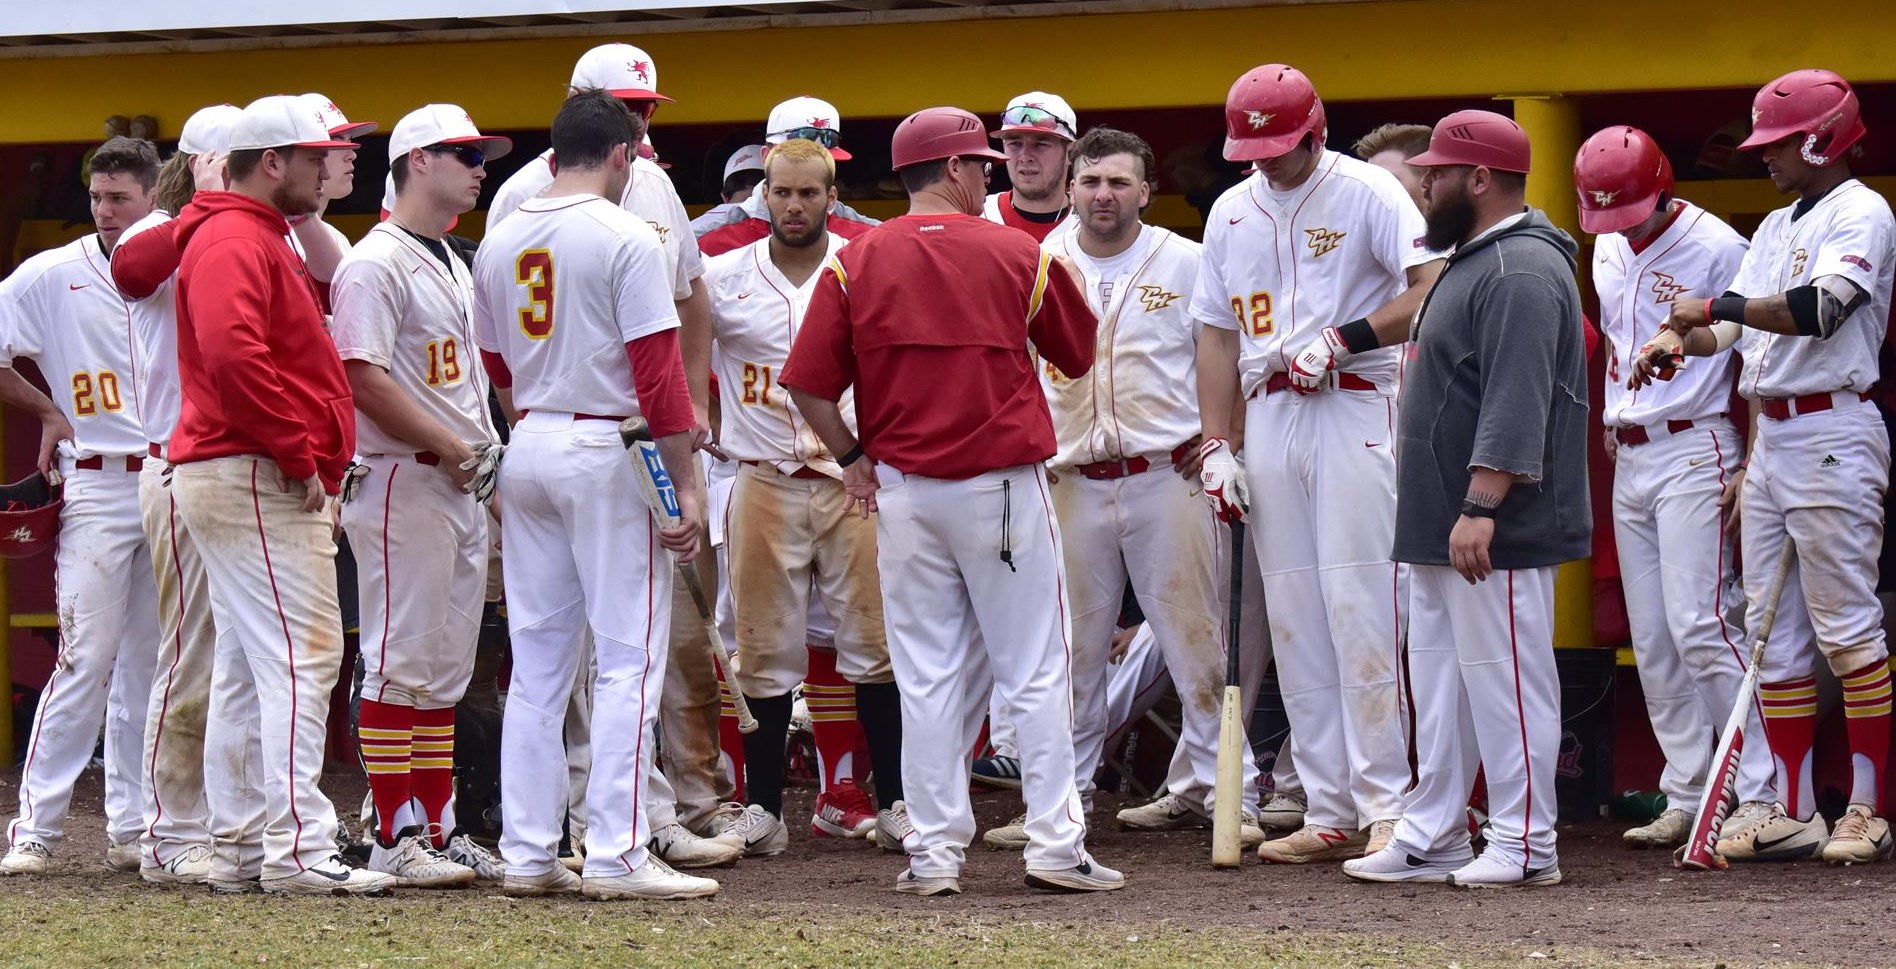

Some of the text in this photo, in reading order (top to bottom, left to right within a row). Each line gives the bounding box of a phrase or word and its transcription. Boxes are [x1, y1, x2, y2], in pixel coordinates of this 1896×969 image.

[515, 248, 555, 339] 3
[425, 337, 462, 386] 19
[741, 361, 771, 405] 21
[71, 370, 123, 417] 20
